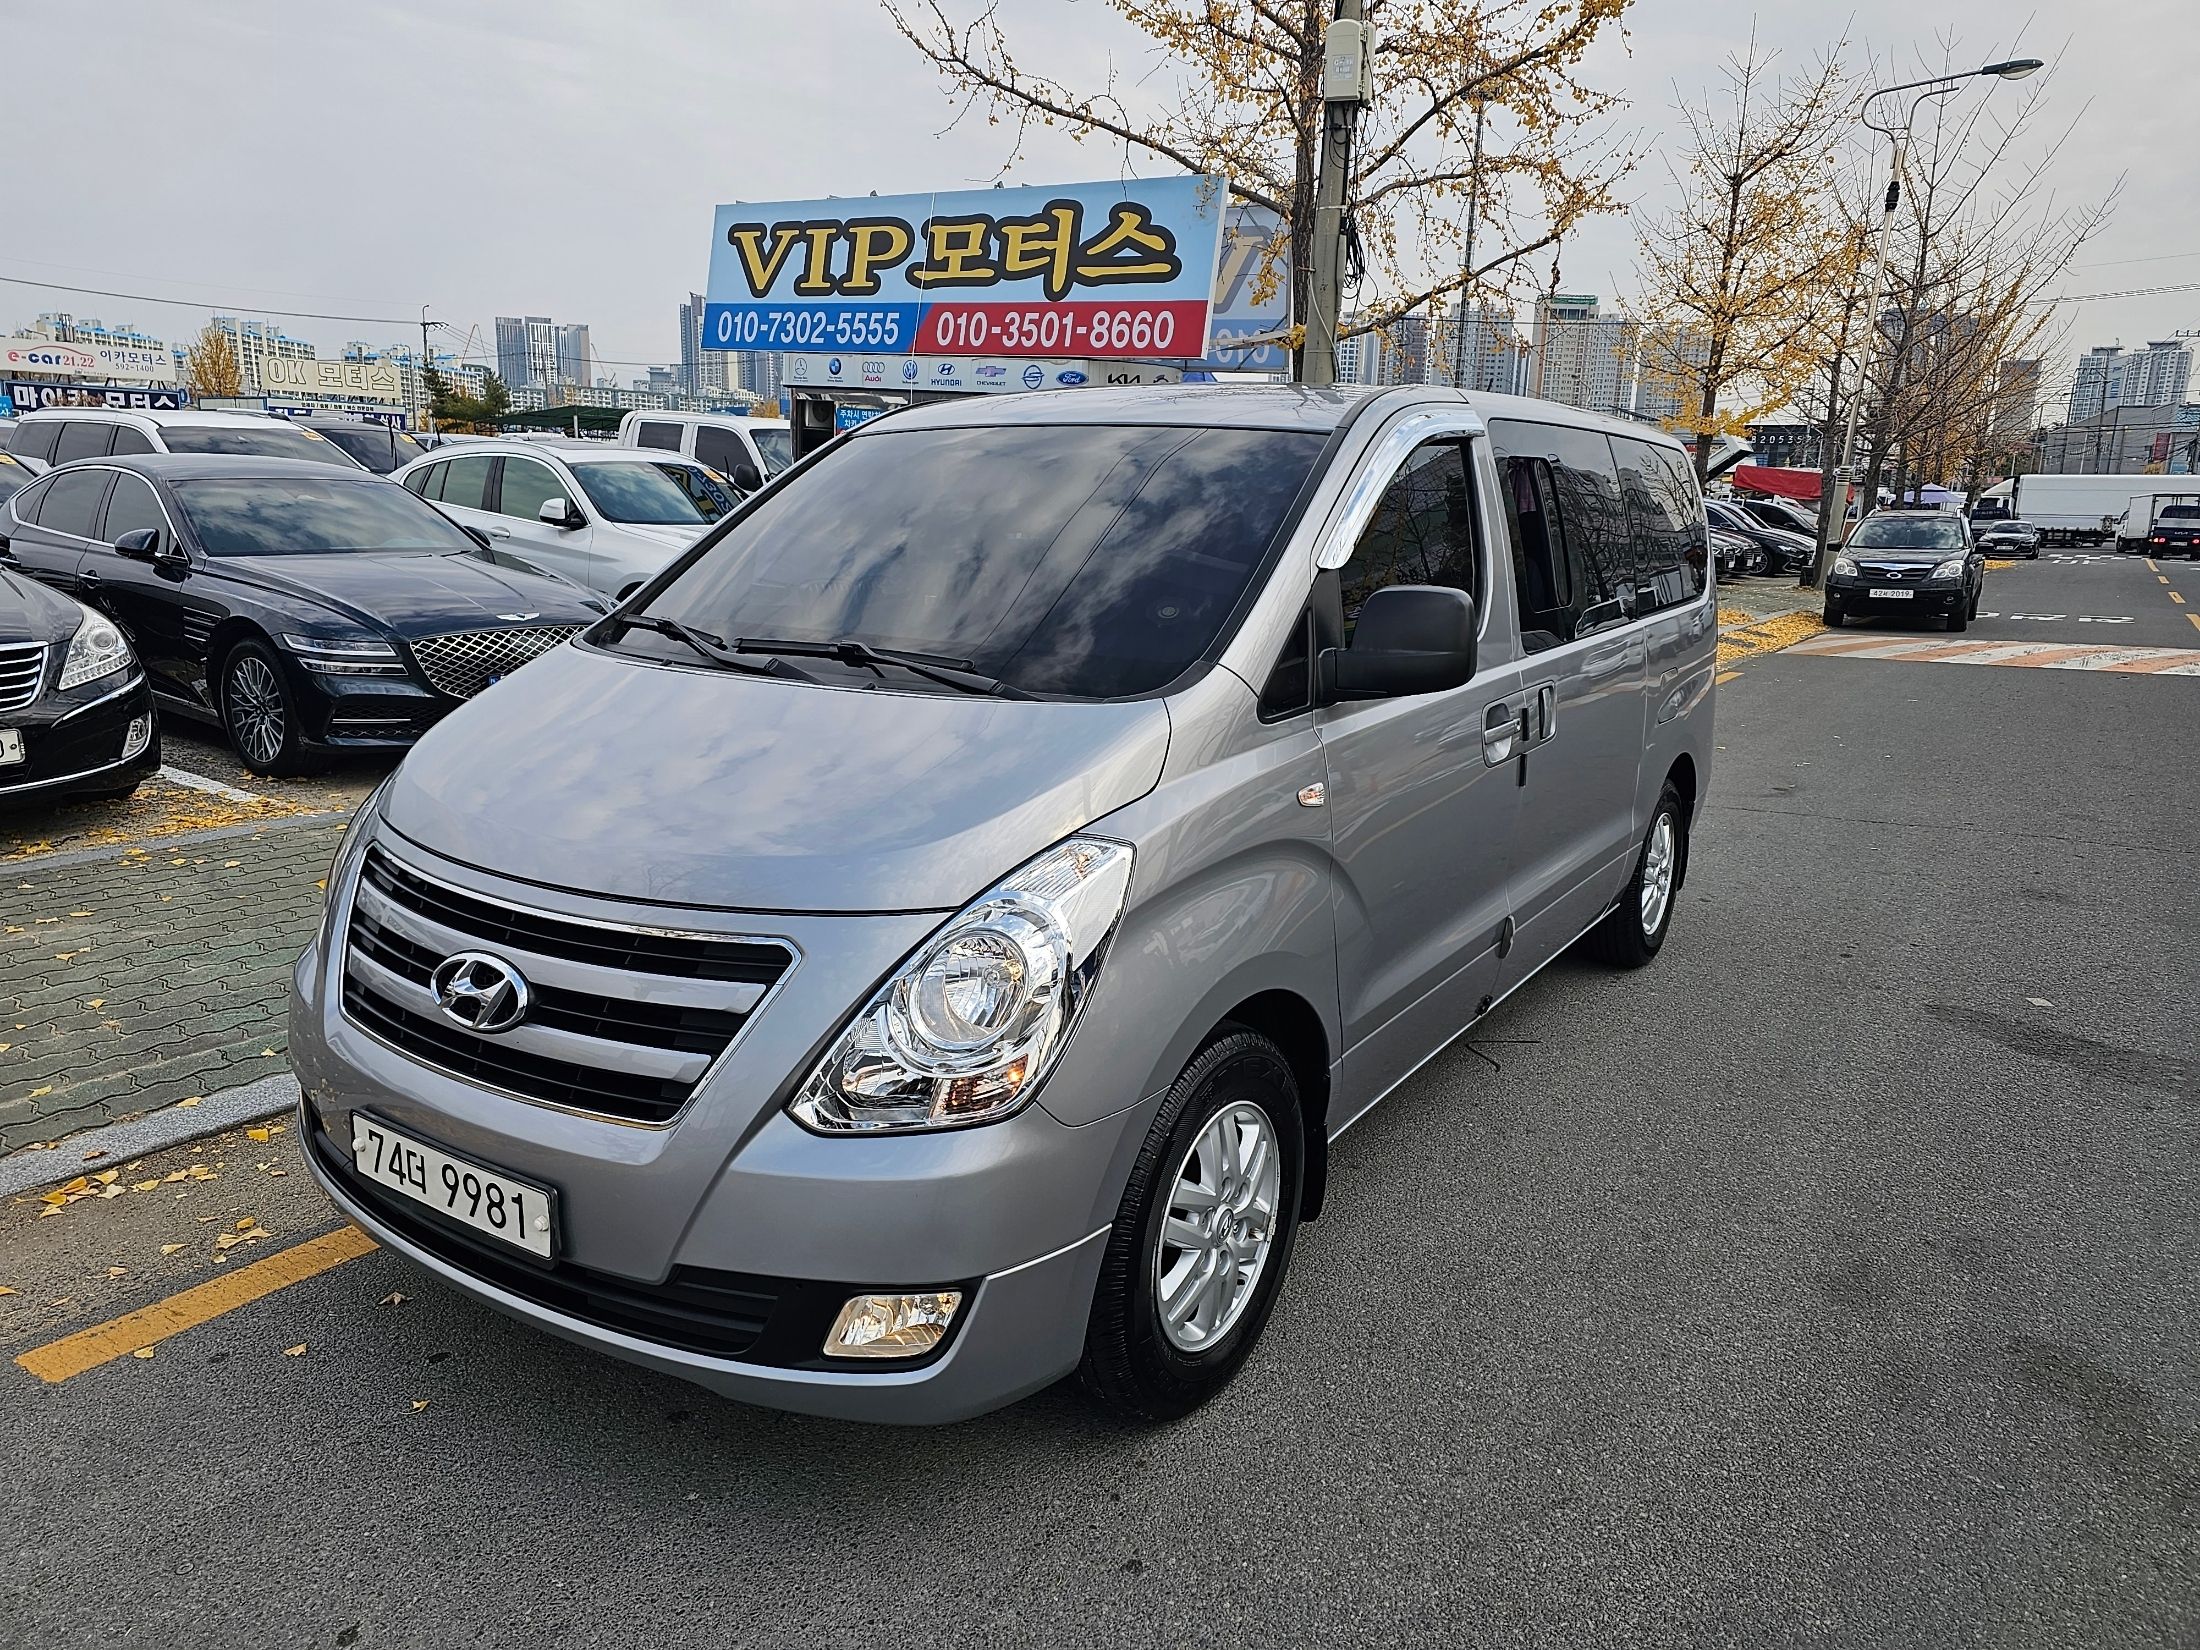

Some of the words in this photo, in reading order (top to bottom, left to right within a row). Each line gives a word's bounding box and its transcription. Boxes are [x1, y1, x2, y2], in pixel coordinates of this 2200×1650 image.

[717, 310, 900, 346] 010-7302-5555
[936, 310, 1175, 349] 010-3501-8660
[99, 349, 167, 366] 이카모터스
[267, 357, 307, 384] OK
[317, 361, 396, 392] 모터스
[864, 374, 882, 383] Audi
[931, 378, 962, 387] HYUNDAI
[839, 409, 860, 419] 주차시
[1890, 590, 1910, 598] 2019
[367, 1128, 427, 1195] 74더
[441, 1163, 526, 1240] 9981
